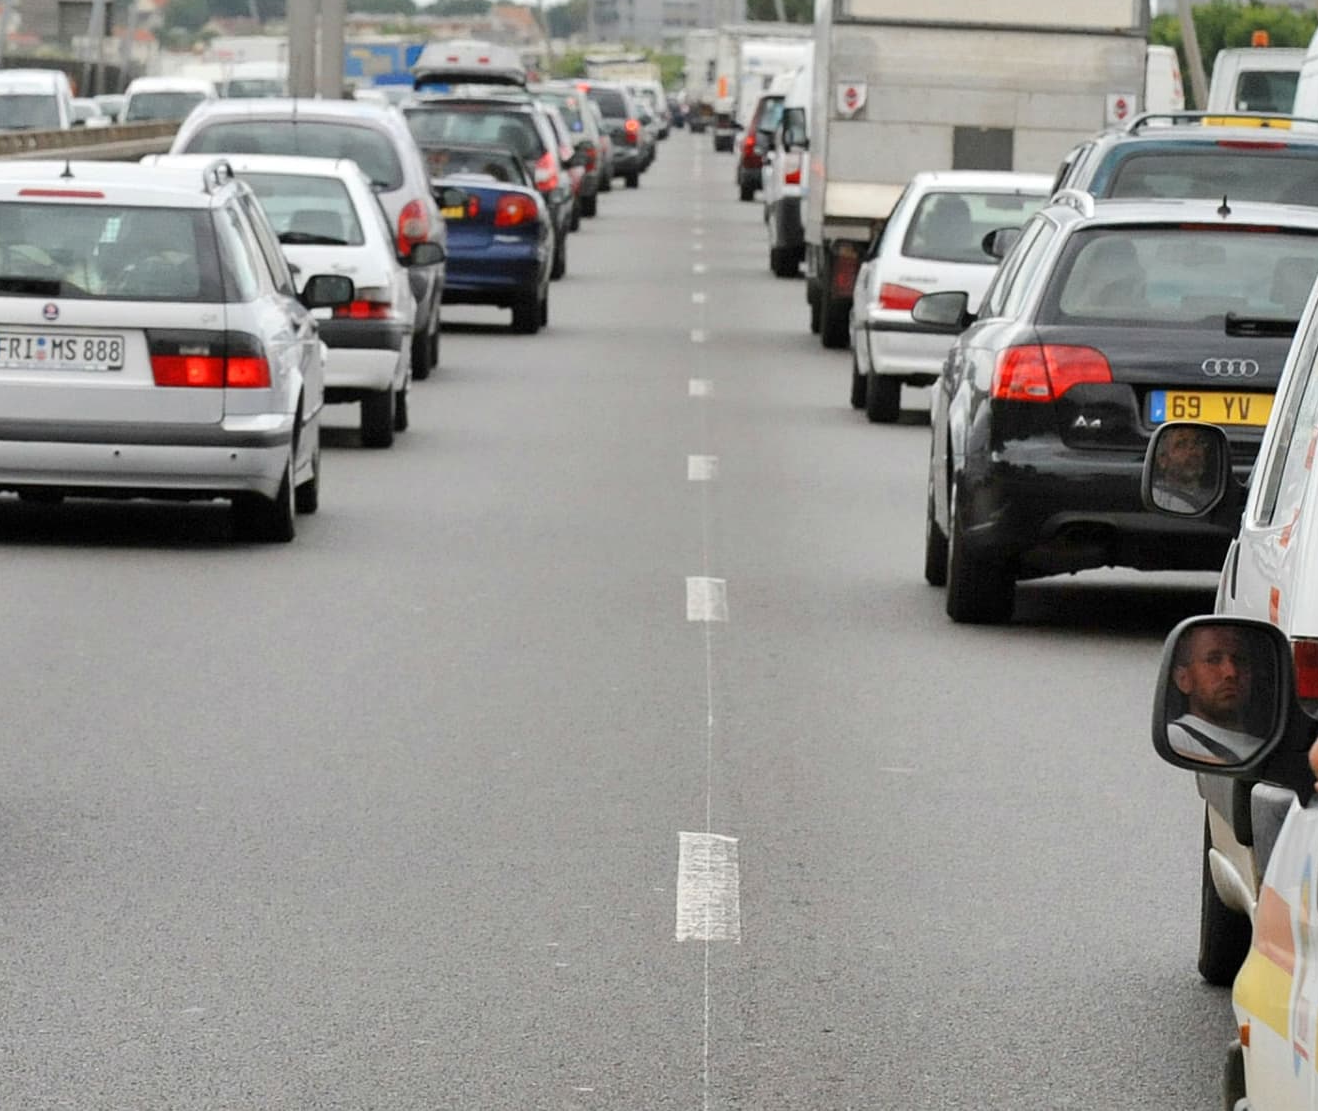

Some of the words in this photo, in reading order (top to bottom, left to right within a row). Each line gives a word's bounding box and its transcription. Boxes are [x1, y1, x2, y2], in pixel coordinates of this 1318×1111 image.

[51, 339, 78, 361] MS
[83, 340, 121, 362] 888
[1172, 395, 1201, 419] 69
[1223, 397, 1251, 421] YV
[1074, 415, 1102, 428] A4
